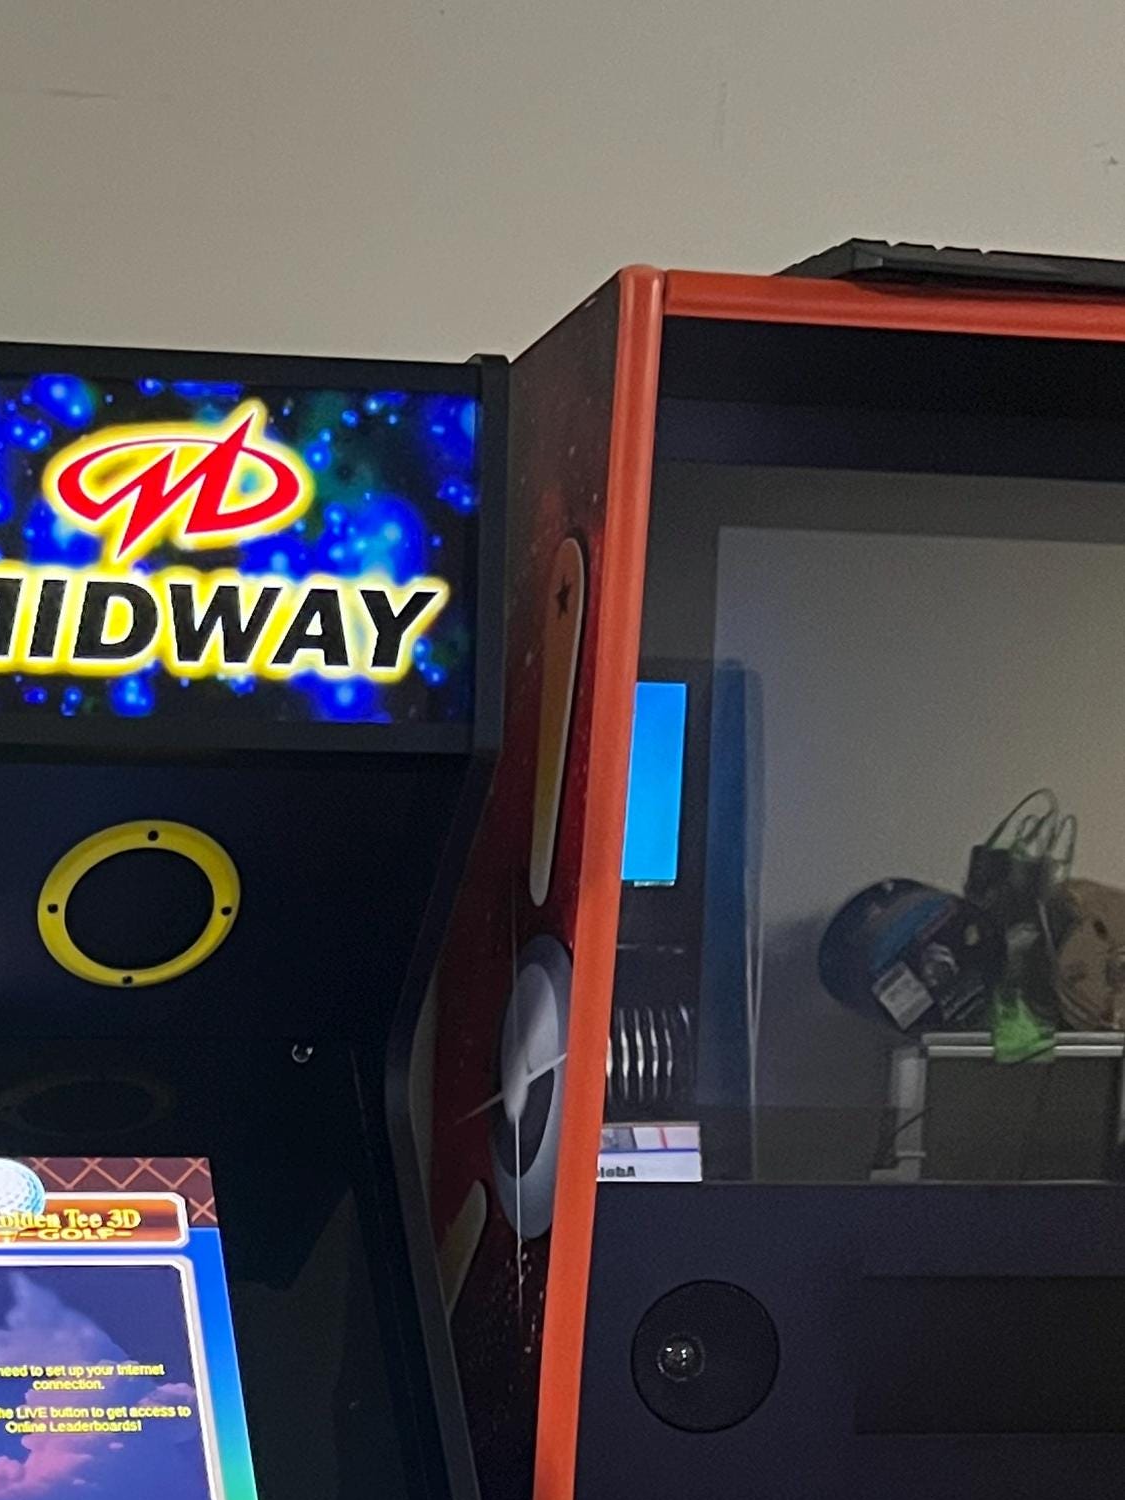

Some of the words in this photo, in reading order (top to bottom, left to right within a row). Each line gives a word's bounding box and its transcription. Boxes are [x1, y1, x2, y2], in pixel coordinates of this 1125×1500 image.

[65, 1209, 102, 1229] Tee
[107, 1209, 141, 1229] 3D
[30, 1366, 43, 1377] to
[69, 1366, 84, 1379] up
[86, 1366, 114, 1378] your
[16, 1408, 48, 1418] LIVE
[51, 1407, 88, 1418] button
[92, 1407, 104, 1418] to
[107, 1407, 127, 1420] get
[177, 1407, 191, 1417] to
